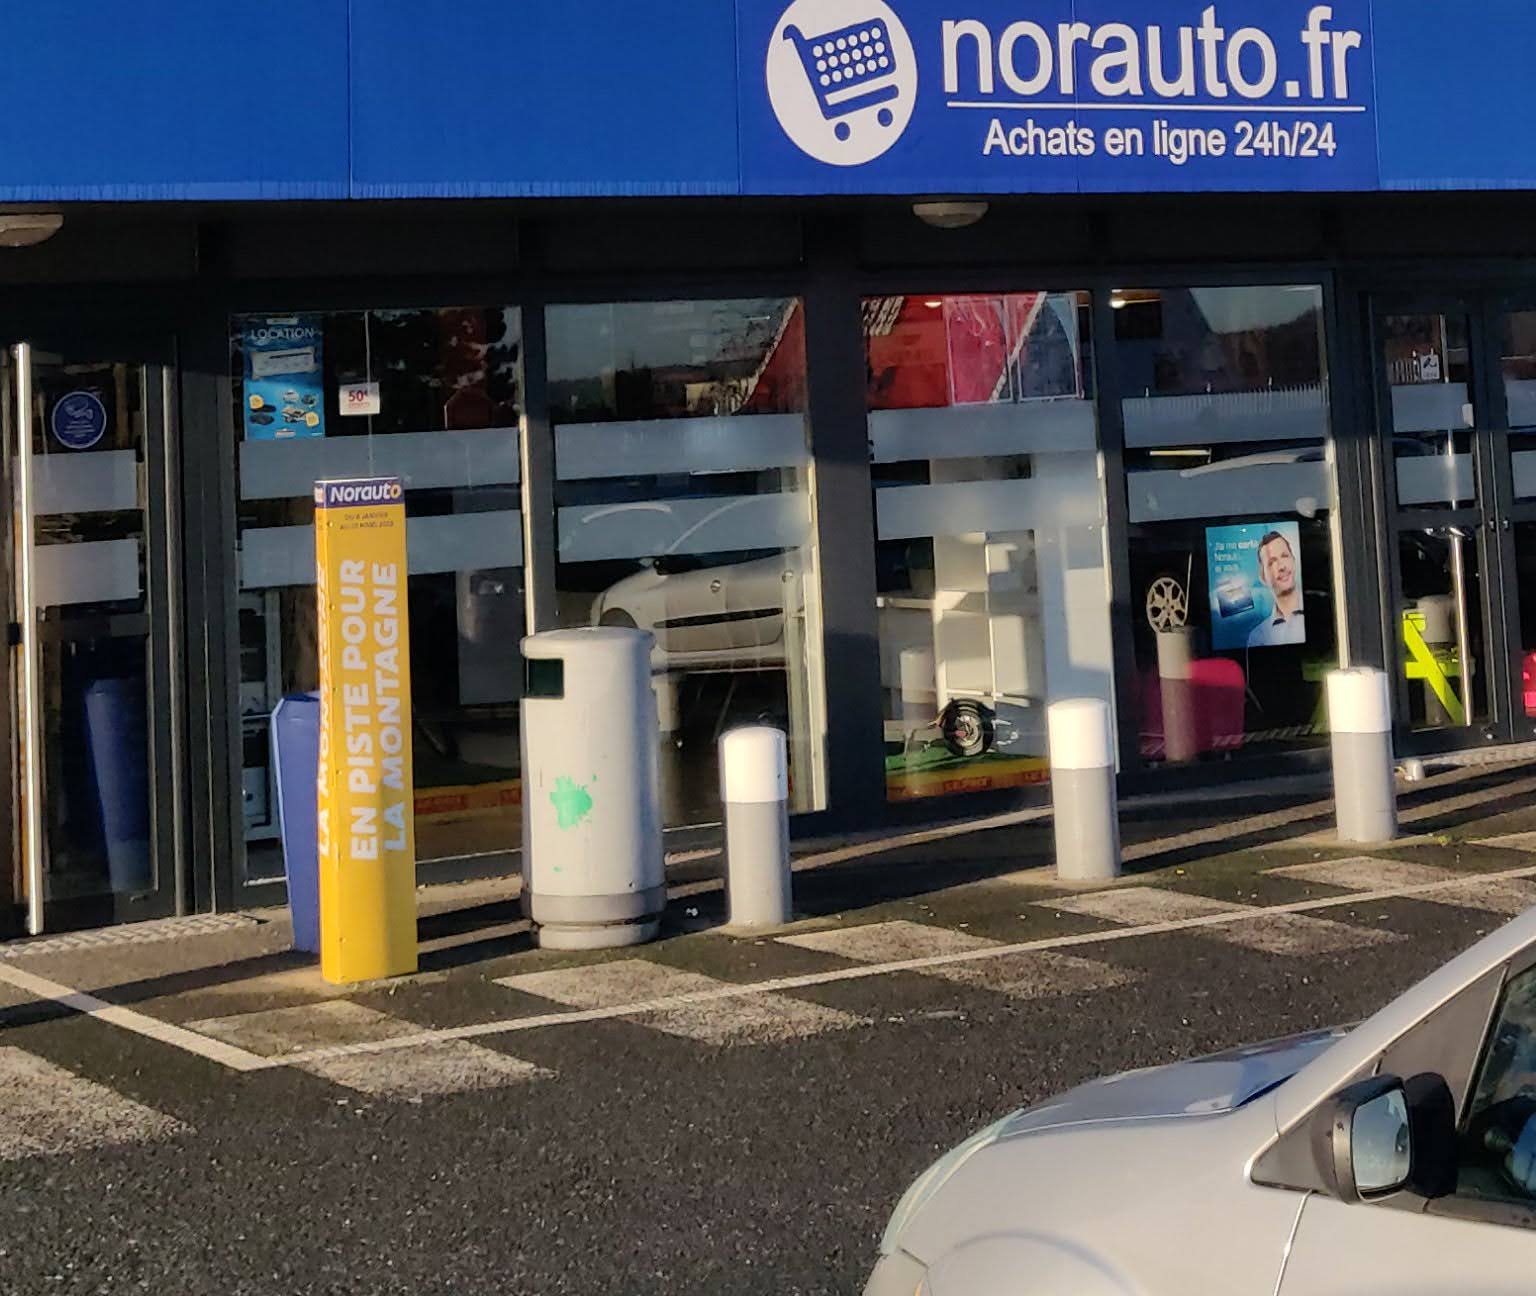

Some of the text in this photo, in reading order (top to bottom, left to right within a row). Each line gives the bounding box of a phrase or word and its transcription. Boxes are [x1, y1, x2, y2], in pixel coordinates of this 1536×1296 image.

[941, 4, 1362, 100] norauto.fr
[982, 118, 1338, 166] Achats en ligne 24h/24
[251, 328, 314, 340] LOCATION
[330, 483, 402, 503] Norauto
[340, 559, 378, 861] EN PISTE POUR
[371, 562, 406, 852] LA MONTAGNE
